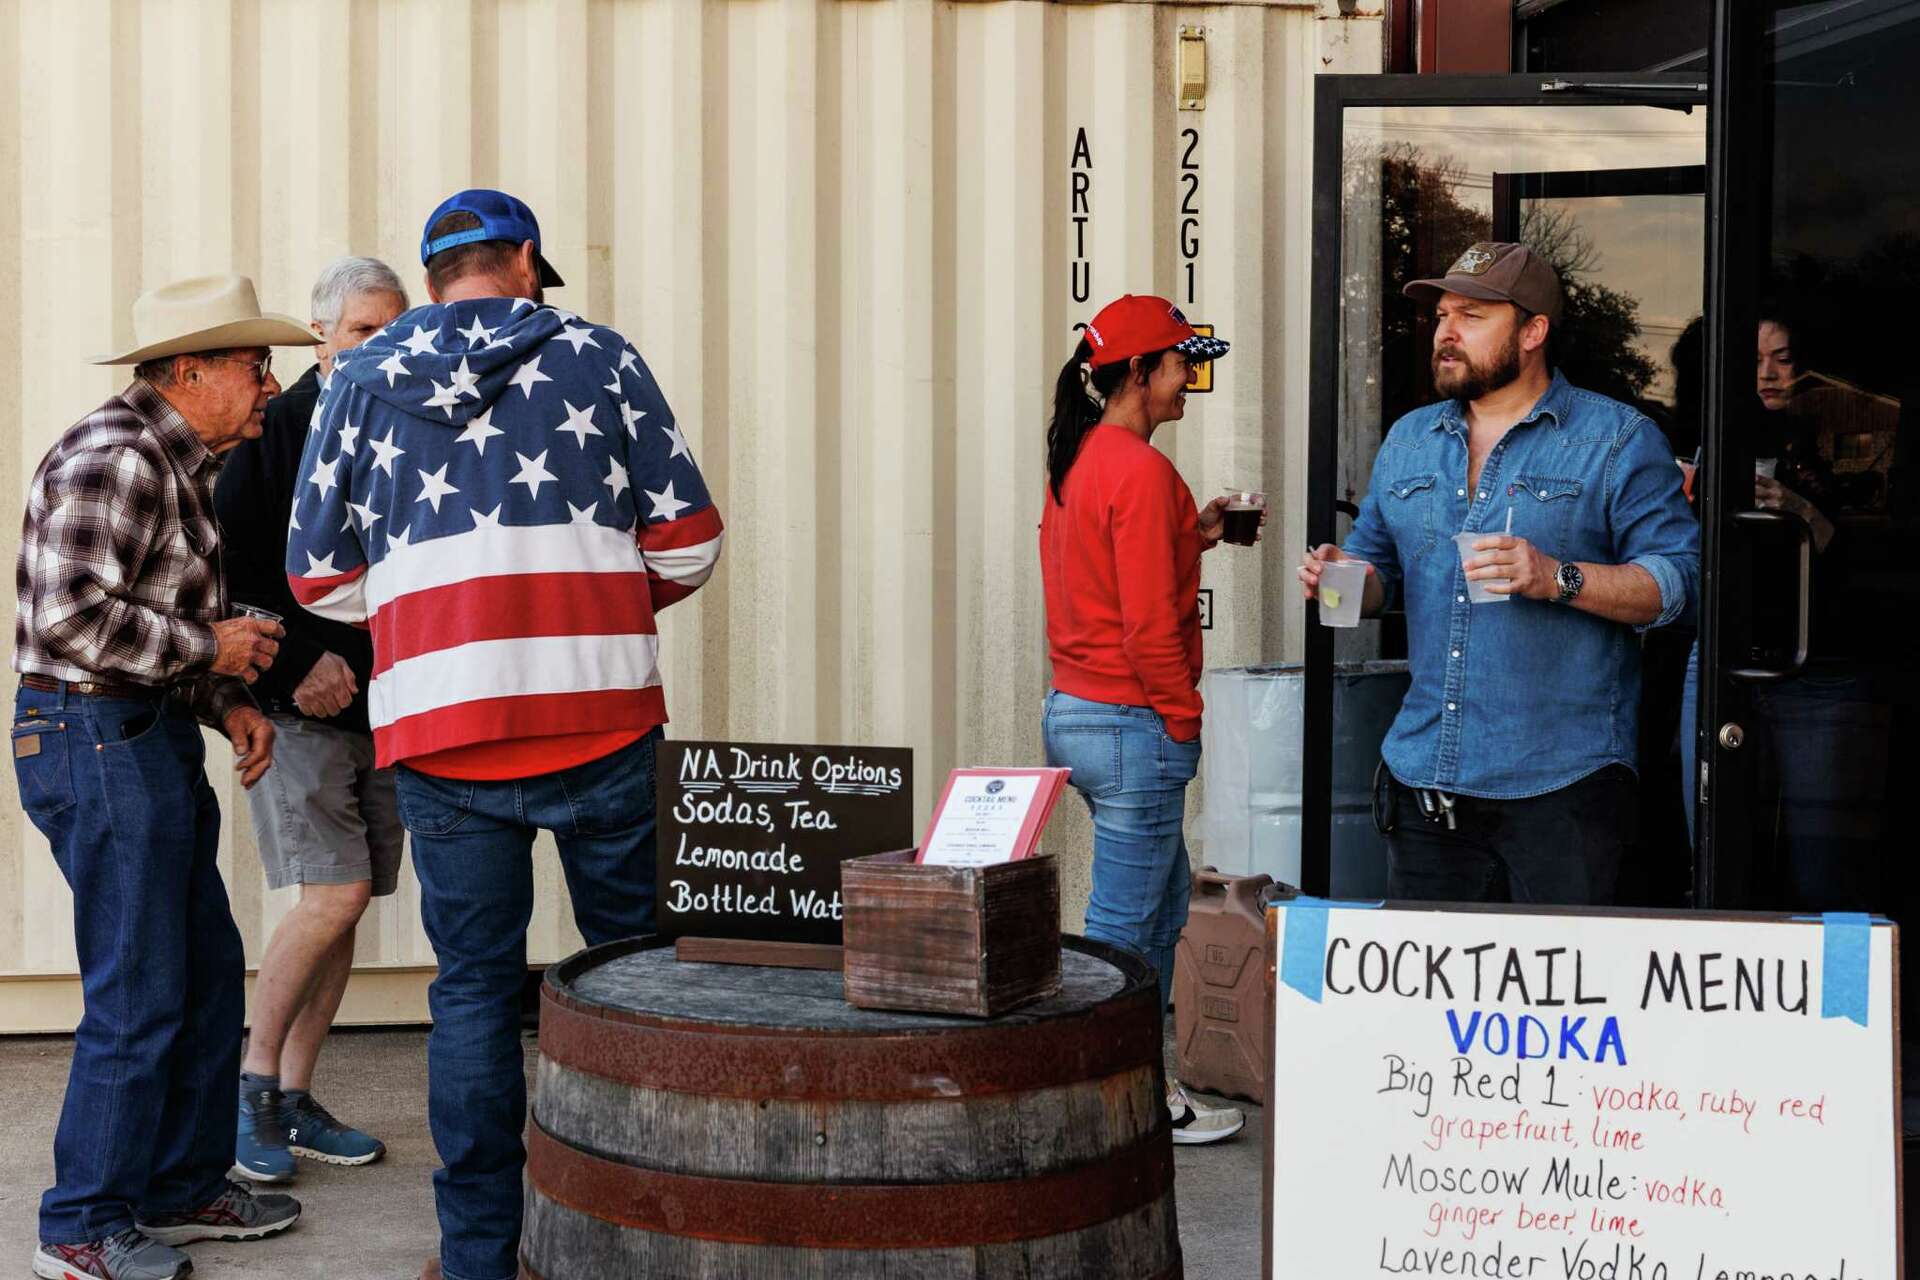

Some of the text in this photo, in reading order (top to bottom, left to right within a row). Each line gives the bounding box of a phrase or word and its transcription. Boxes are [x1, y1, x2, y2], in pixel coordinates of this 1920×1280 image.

[1071, 127, 1092, 303] ARTU
[1181, 128, 1199, 304] 22G1
[680, 748, 902, 796] NA Drink Options
[674, 793, 838, 833] Sodas, Tea
[676, 833, 804, 874] Lemonade
[667, 880, 780, 915] Bottled
[1325, 937, 1808, 1016] COCKTAIL MENU
[1446, 1009, 1628, 1066] VODKA
[1377, 1054, 1433, 1118] Big
[1452, 1058, 1522, 1105] Red
[1593, 1079, 1687, 1121] vodka,
[1699, 1090, 1757, 1134] ruby
[1779, 1095, 1825, 1125] red
[1422, 1109, 1645, 1151] grapefruit, lime
[1383, 1153, 1530, 1194] Moscow
[1541, 1157, 1637, 1201] Mule:
[1424, 1202, 1504, 1240] ginger
[1591, 1207, 1645, 1237] lime
[1380, 1236, 1547, 1279] Lavender
